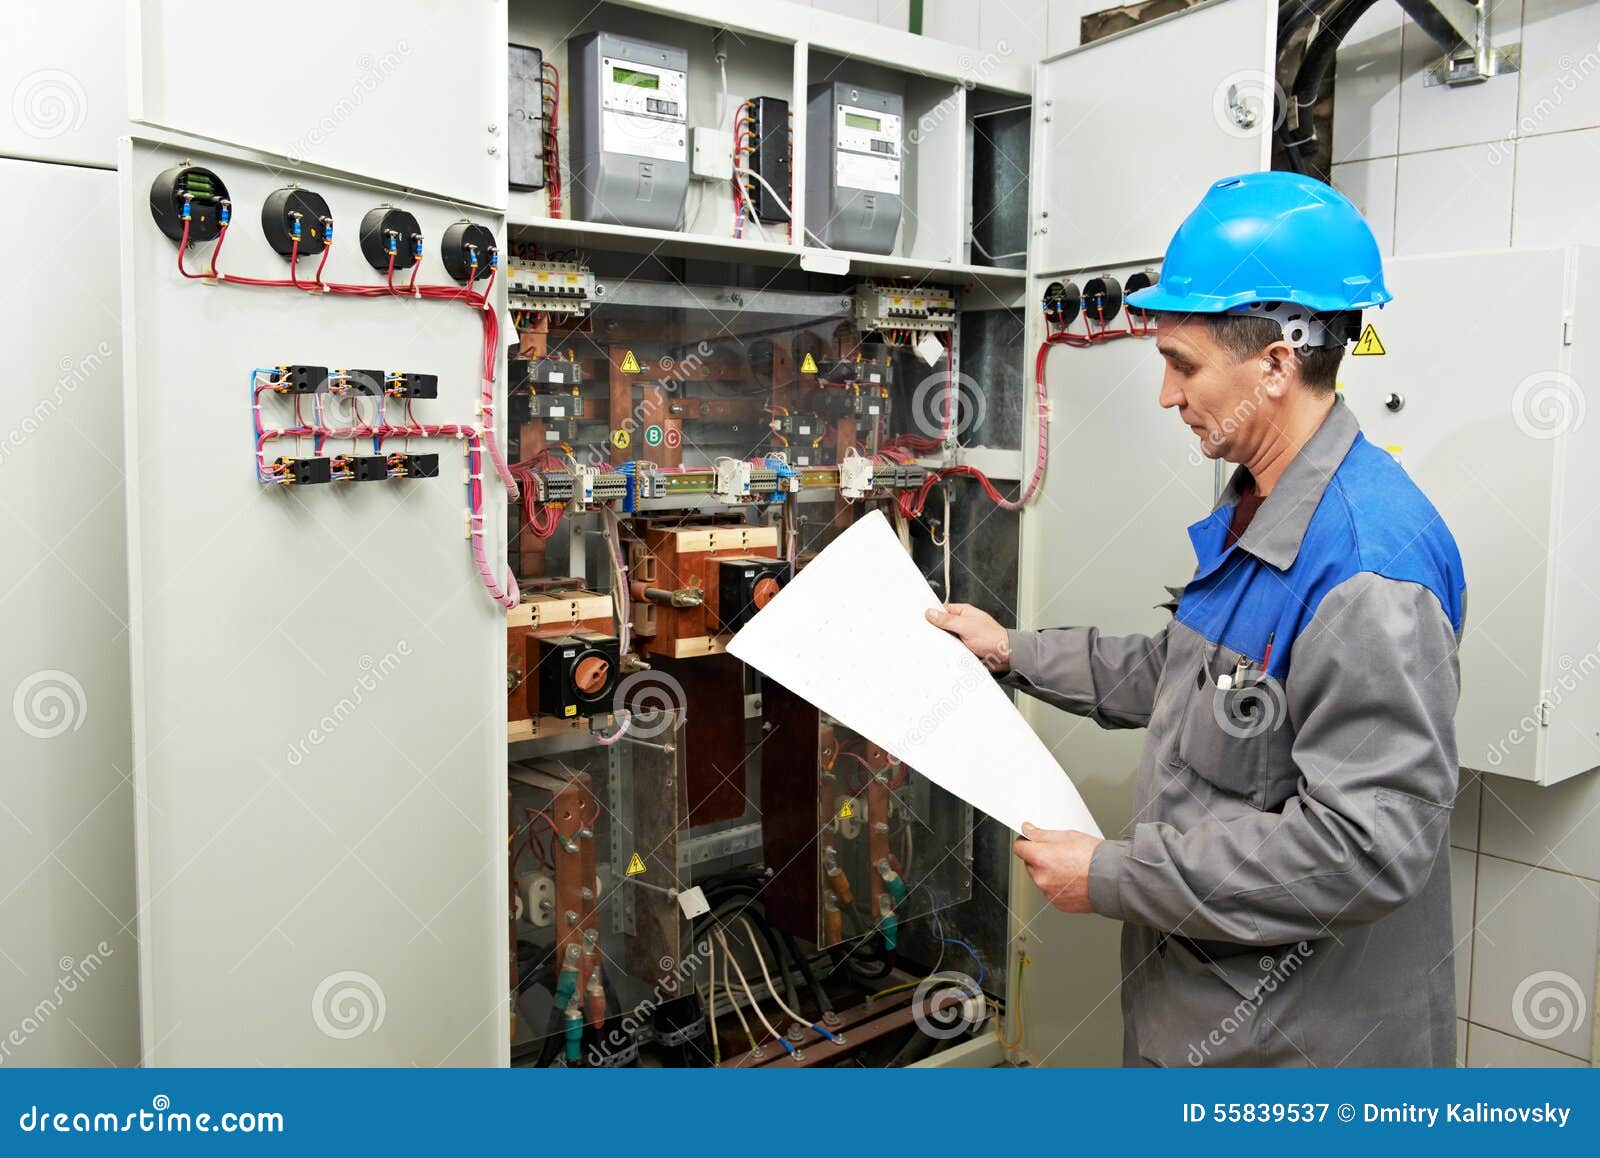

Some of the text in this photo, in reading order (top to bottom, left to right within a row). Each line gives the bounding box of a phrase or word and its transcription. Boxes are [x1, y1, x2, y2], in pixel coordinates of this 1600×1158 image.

[617, 432, 627, 444] A
[649, 429, 659, 442] B
[667, 432, 678, 444] C
